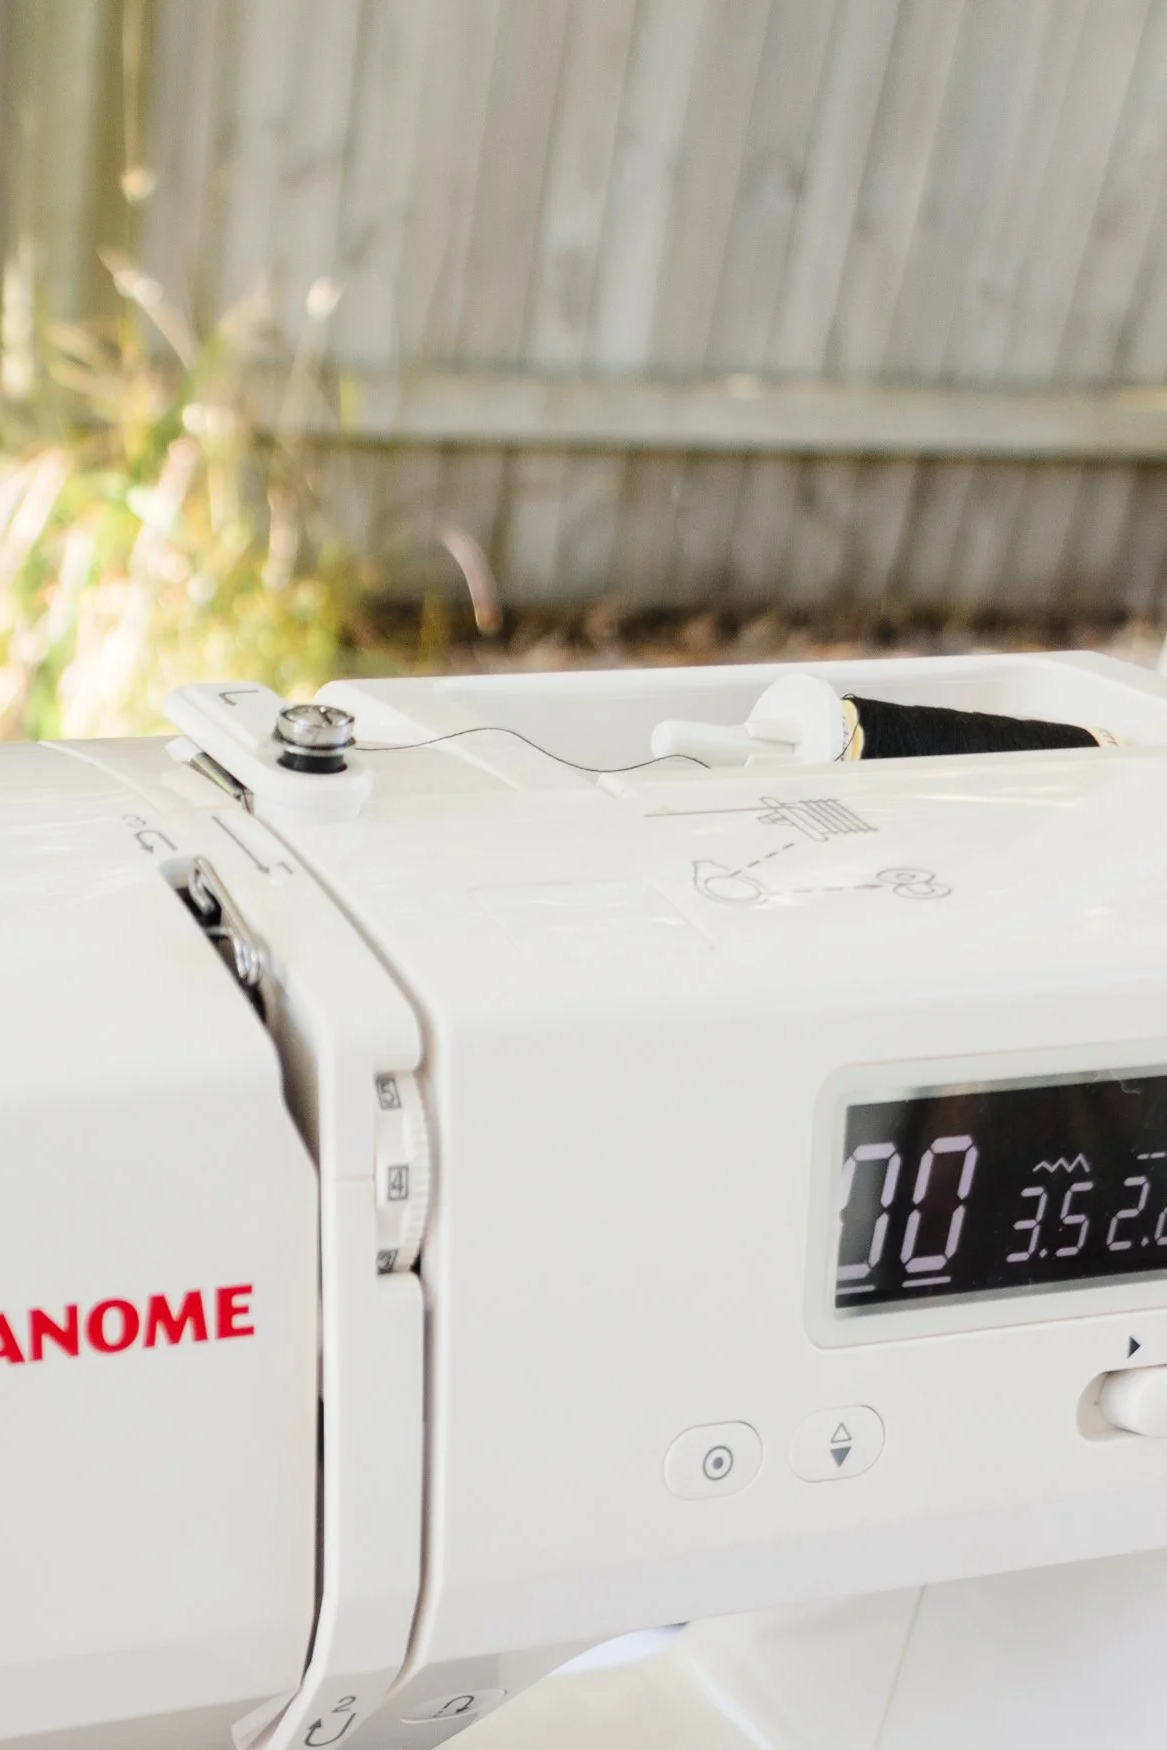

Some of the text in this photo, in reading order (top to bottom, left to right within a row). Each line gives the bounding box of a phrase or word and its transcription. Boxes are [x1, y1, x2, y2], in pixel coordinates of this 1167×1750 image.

[836, 1134, 979, 1281] 00
[1006, 1181, 1094, 1263] 3.5
[331, 1695, 357, 1713] 2
